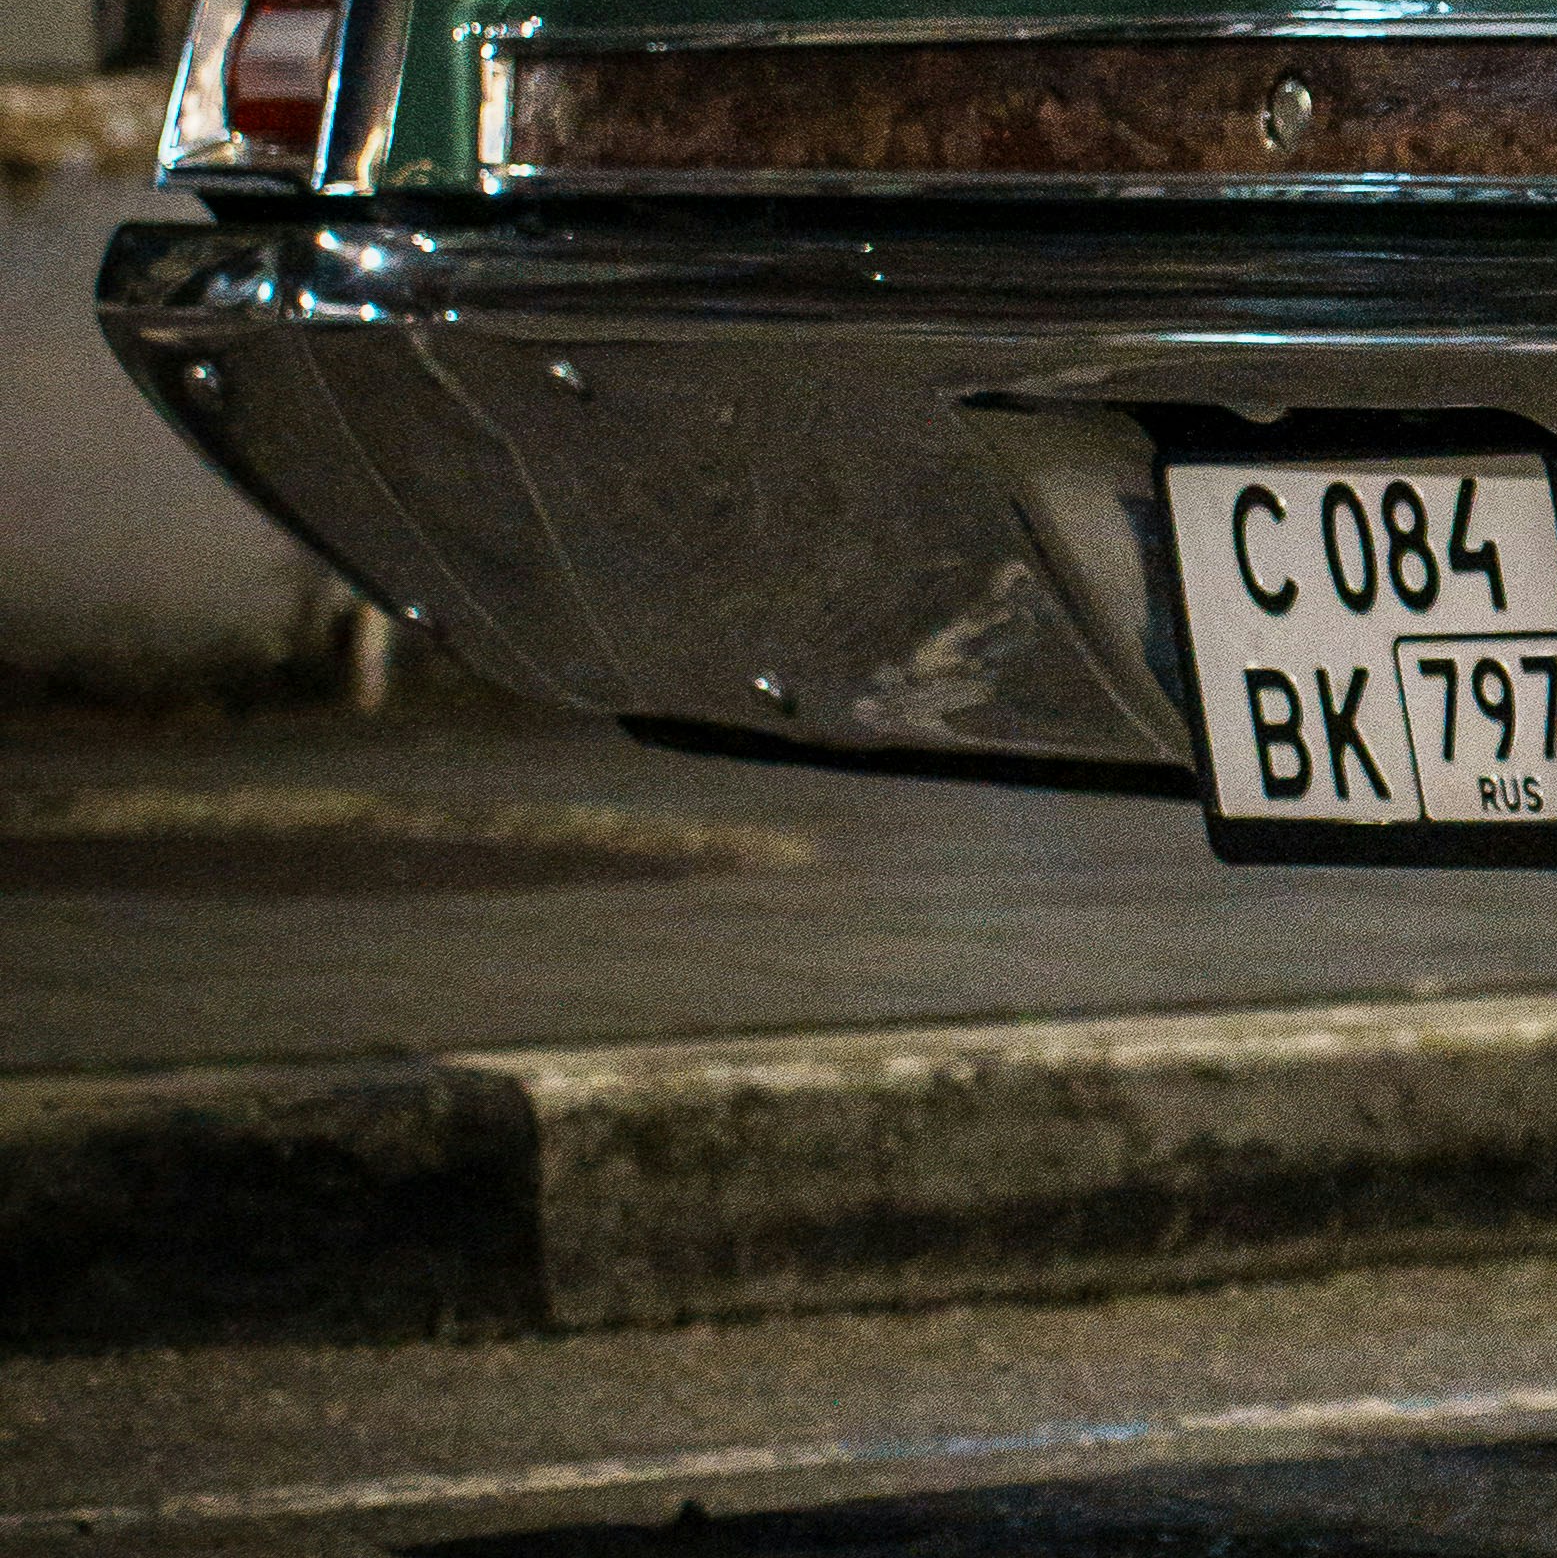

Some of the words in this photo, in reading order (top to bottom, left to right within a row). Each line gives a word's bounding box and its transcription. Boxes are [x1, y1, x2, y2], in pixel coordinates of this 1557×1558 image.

[1232, 483, 1299, 616] C
[1321, 476, 1508, 615] 084
[1243, 664, 1392, 801] BK
[1477, 775, 1545, 814] RUS
